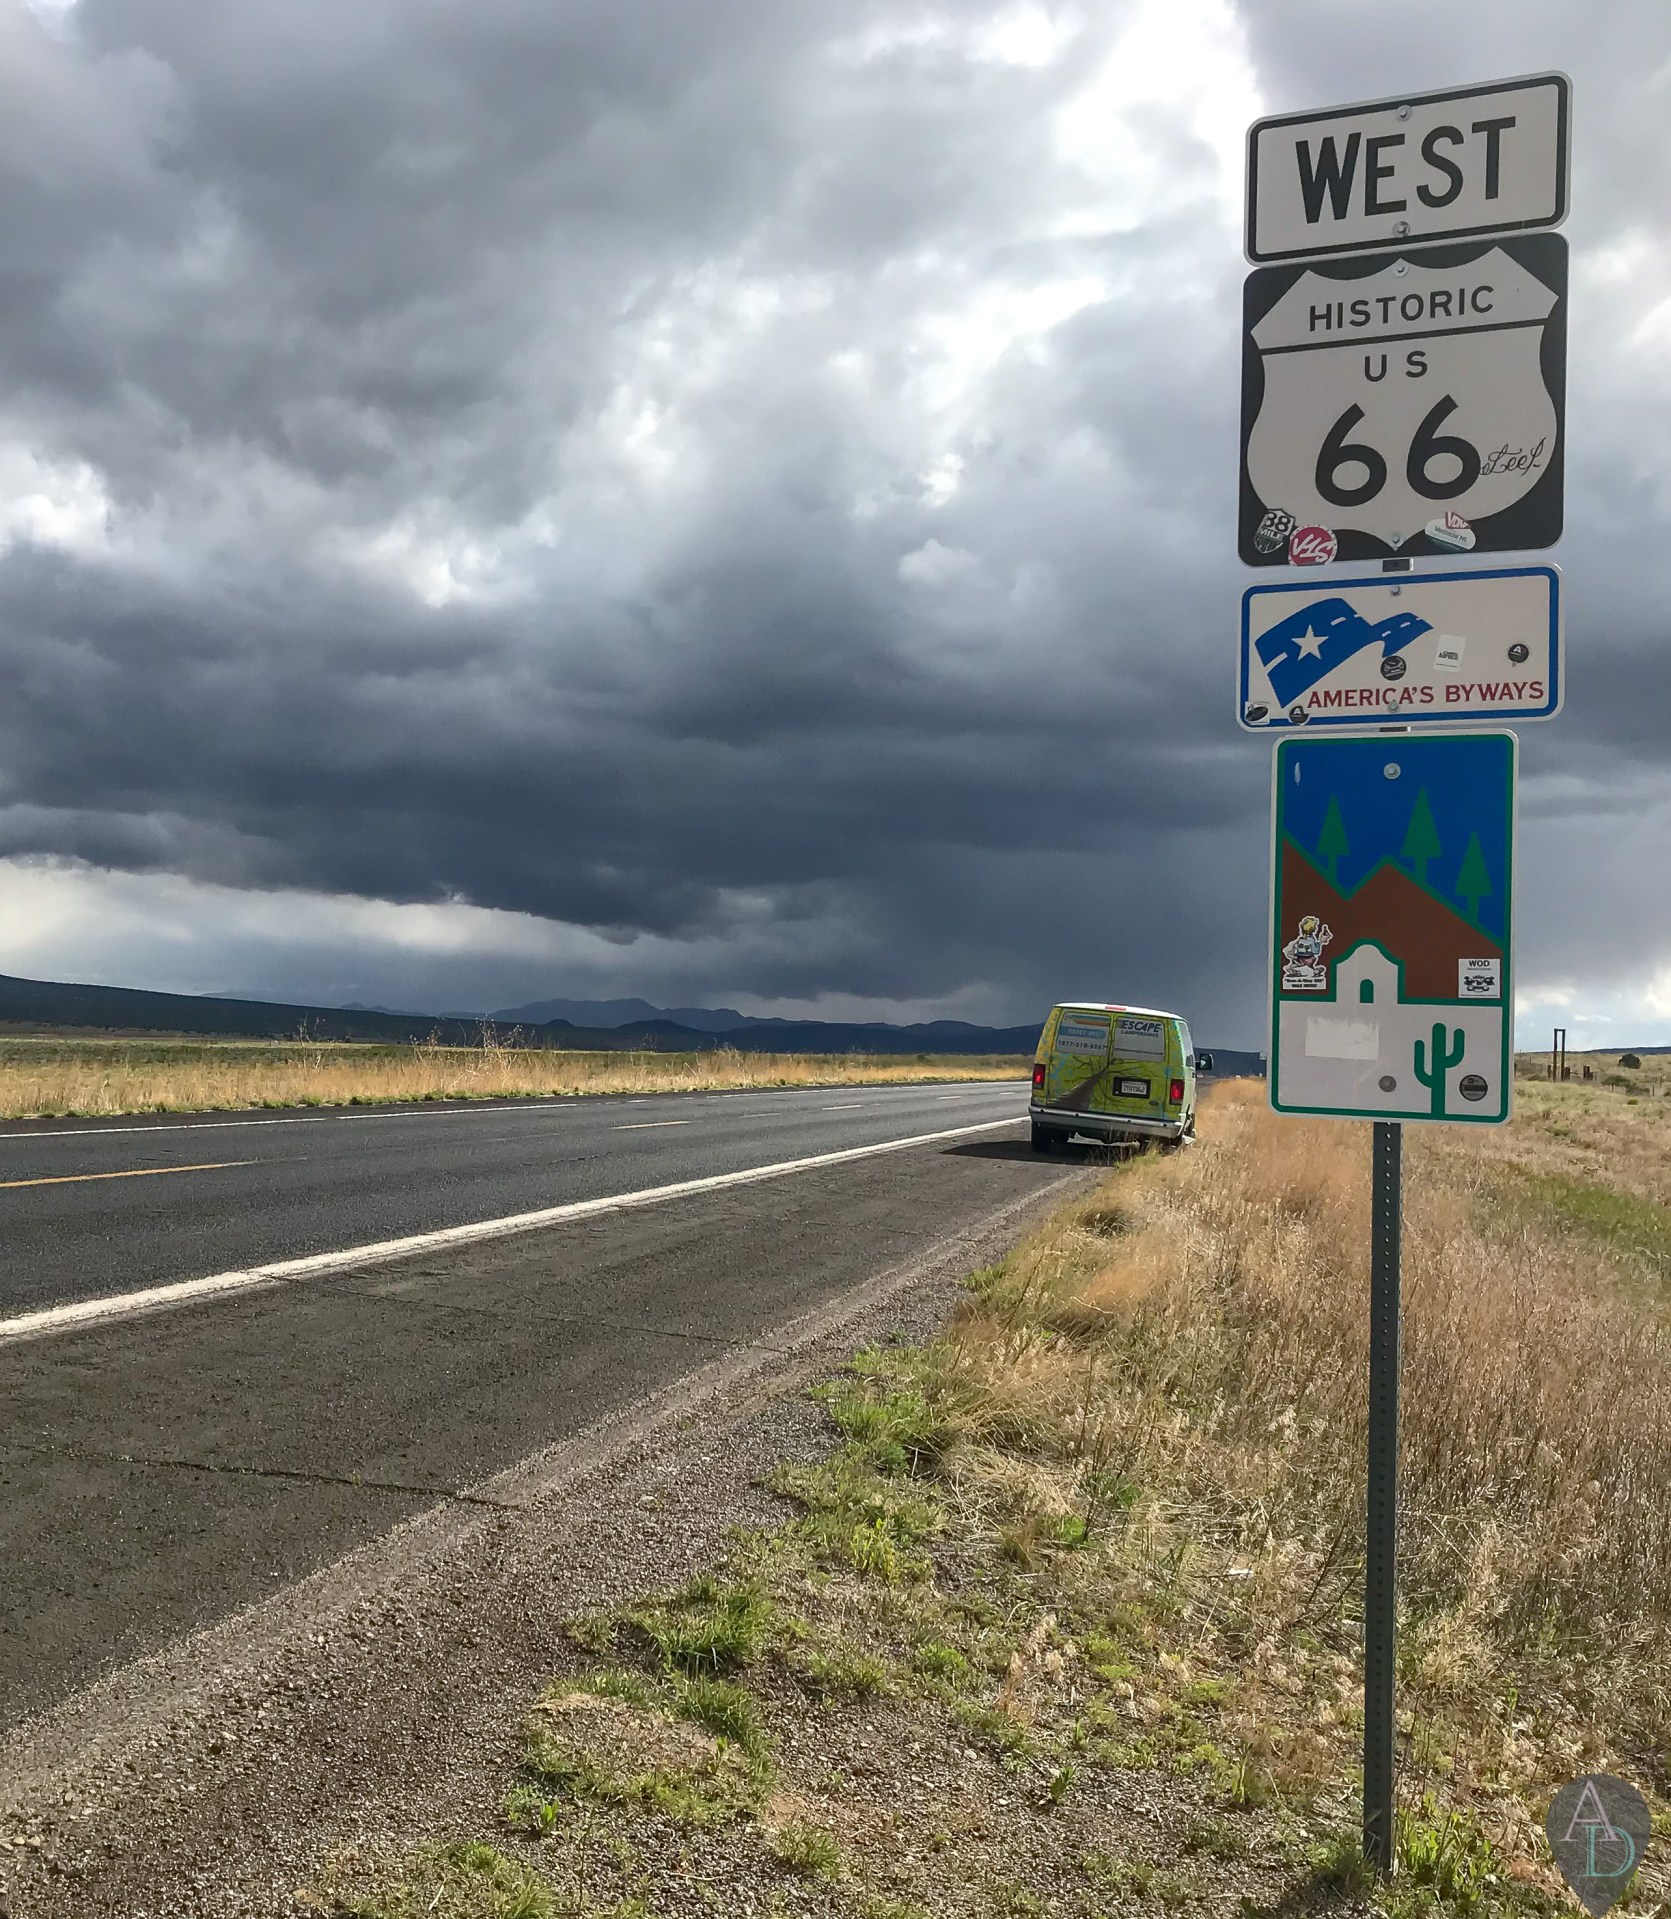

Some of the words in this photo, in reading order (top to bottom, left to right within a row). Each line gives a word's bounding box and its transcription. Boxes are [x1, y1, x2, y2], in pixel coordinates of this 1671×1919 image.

[1295, 116, 1516, 224] WEST
[1309, 285, 1494, 332] HISTORIC
[1315, 393, 1481, 507] 66
[1307, 686, 1434, 708] AMERICA'S
[1445, 681, 1544, 703] BYWAYS
[1121, 1020, 1162, 1033] ESCAPE
